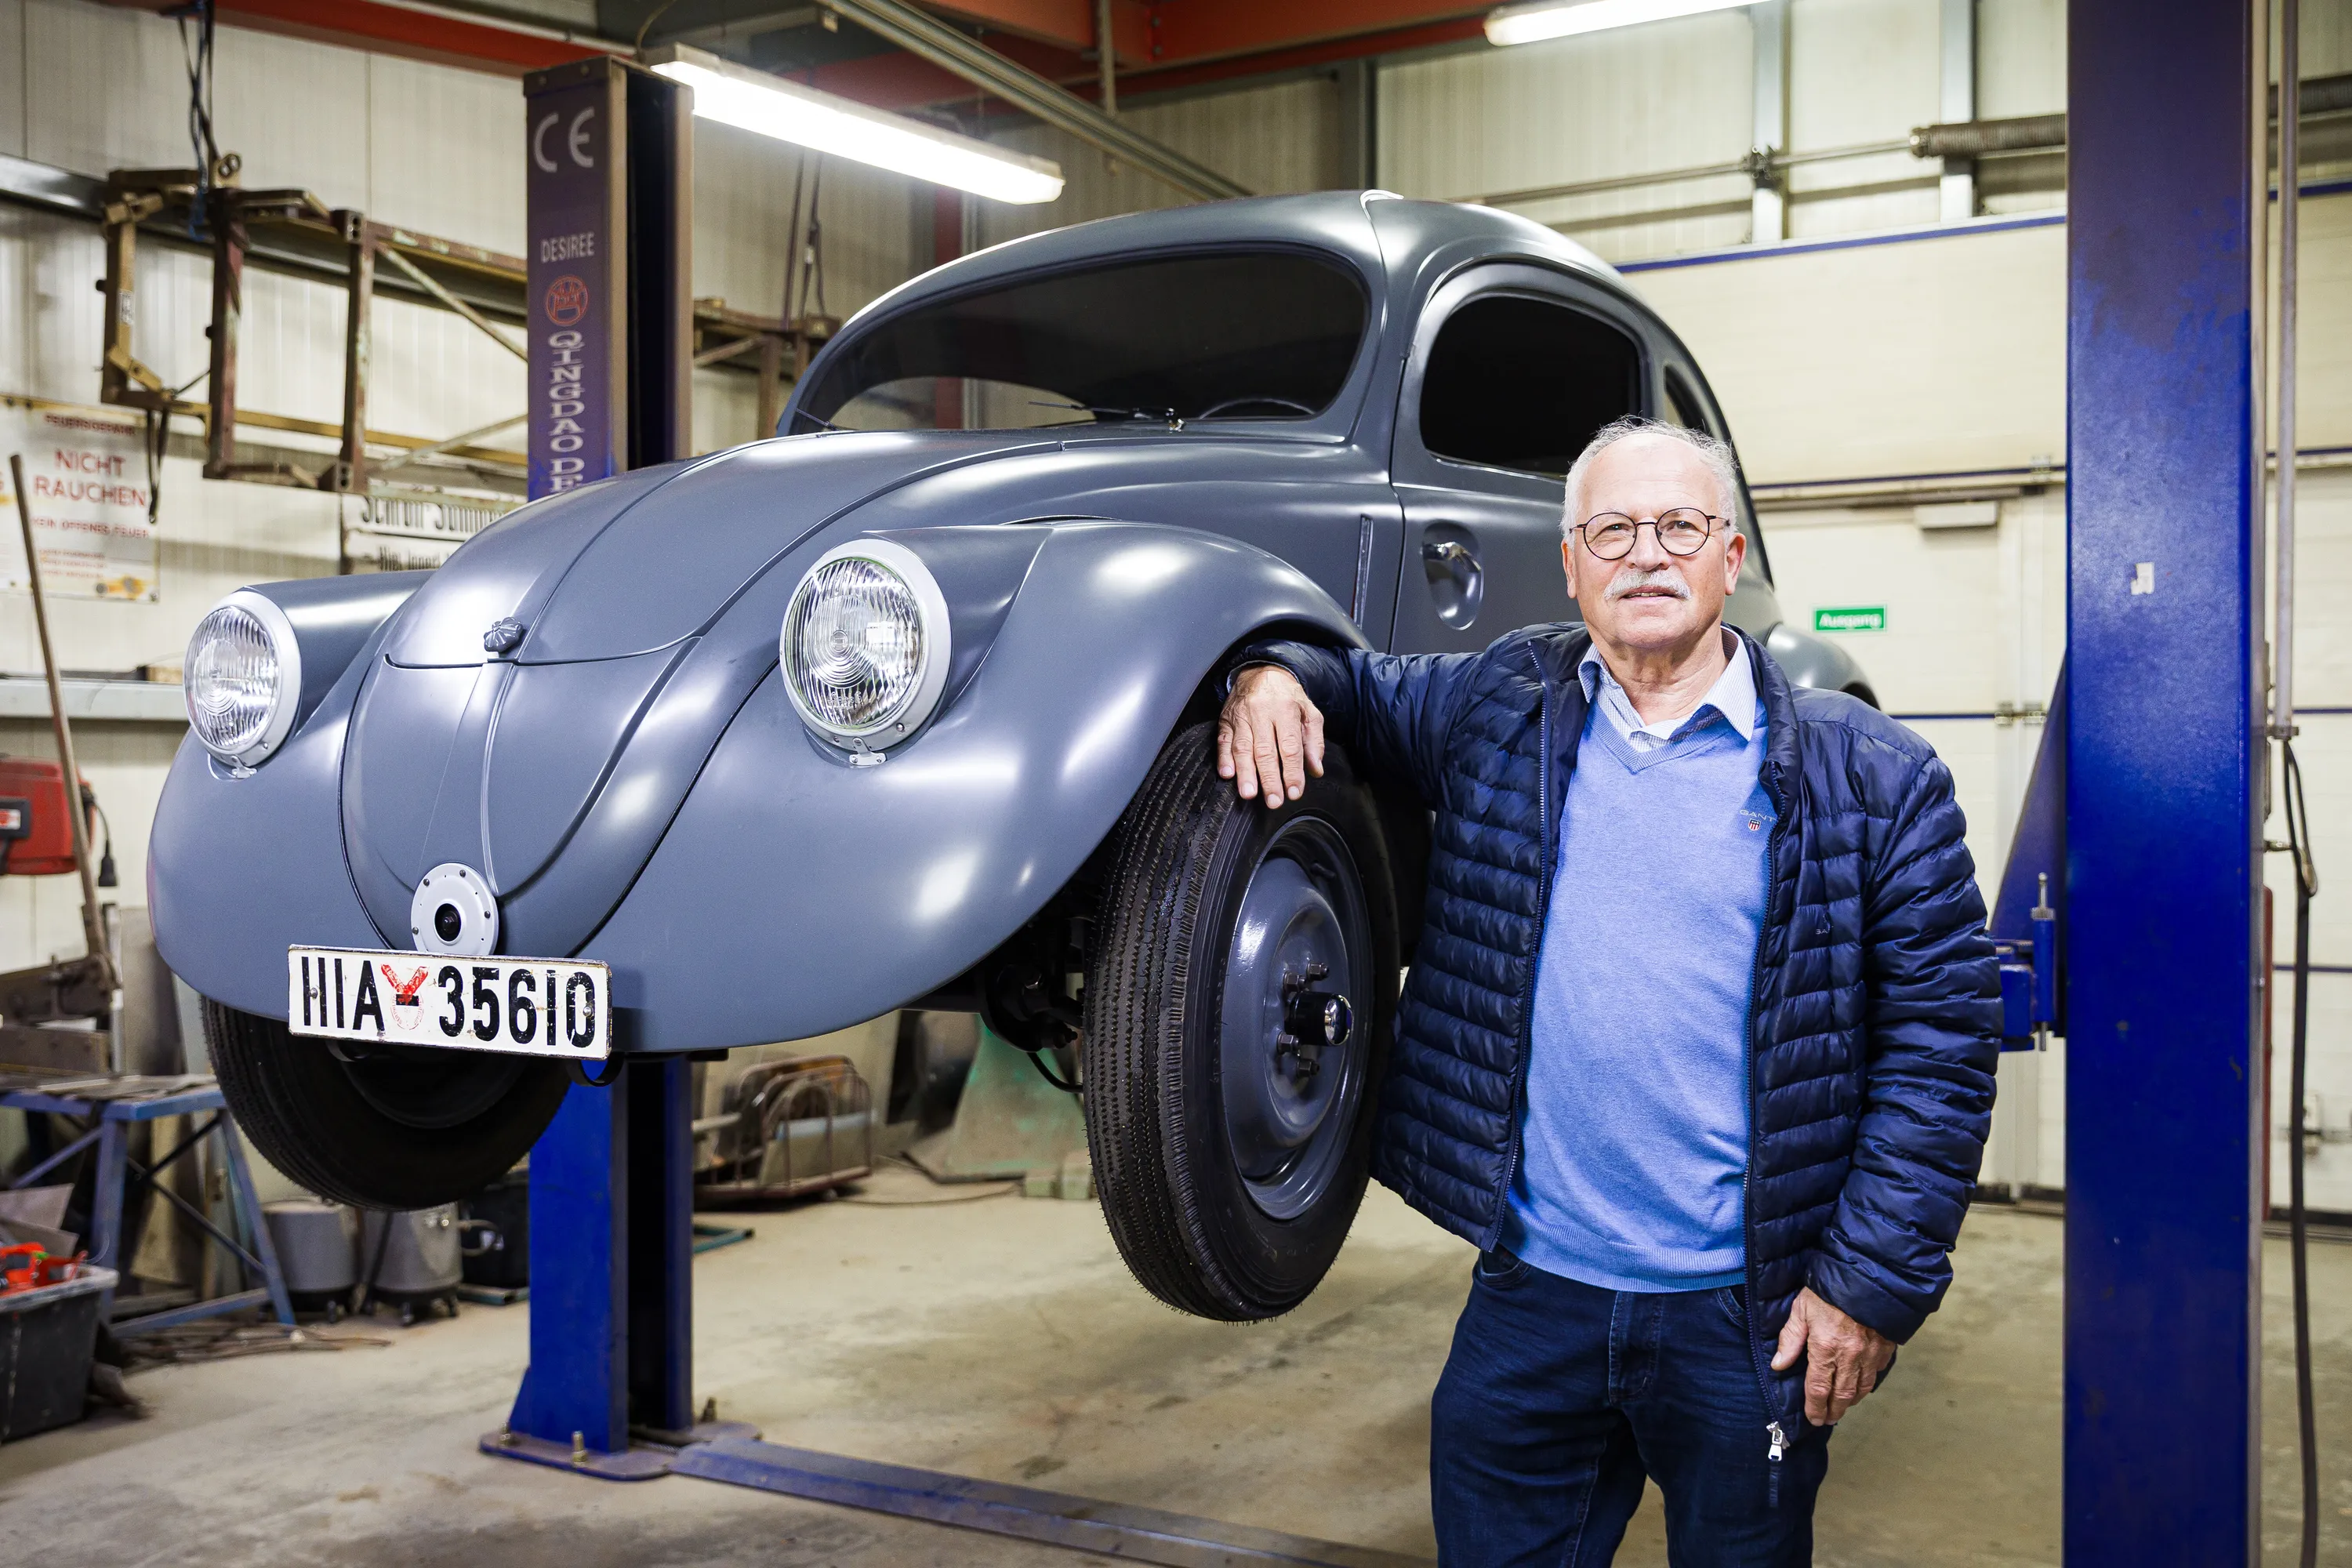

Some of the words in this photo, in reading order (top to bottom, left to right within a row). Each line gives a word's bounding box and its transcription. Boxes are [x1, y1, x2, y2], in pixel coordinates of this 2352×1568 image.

[541, 232, 595, 263] DESIREE
[549, 330, 585, 452] QINGDAO
[56, 448, 125, 477] NICHT
[34, 474, 147, 506] RAUCHEN
[1819, 612, 1882, 630] Ausgang
[1740, 810, 1777, 822] GANT
[438, 965, 596, 1047] 35610
